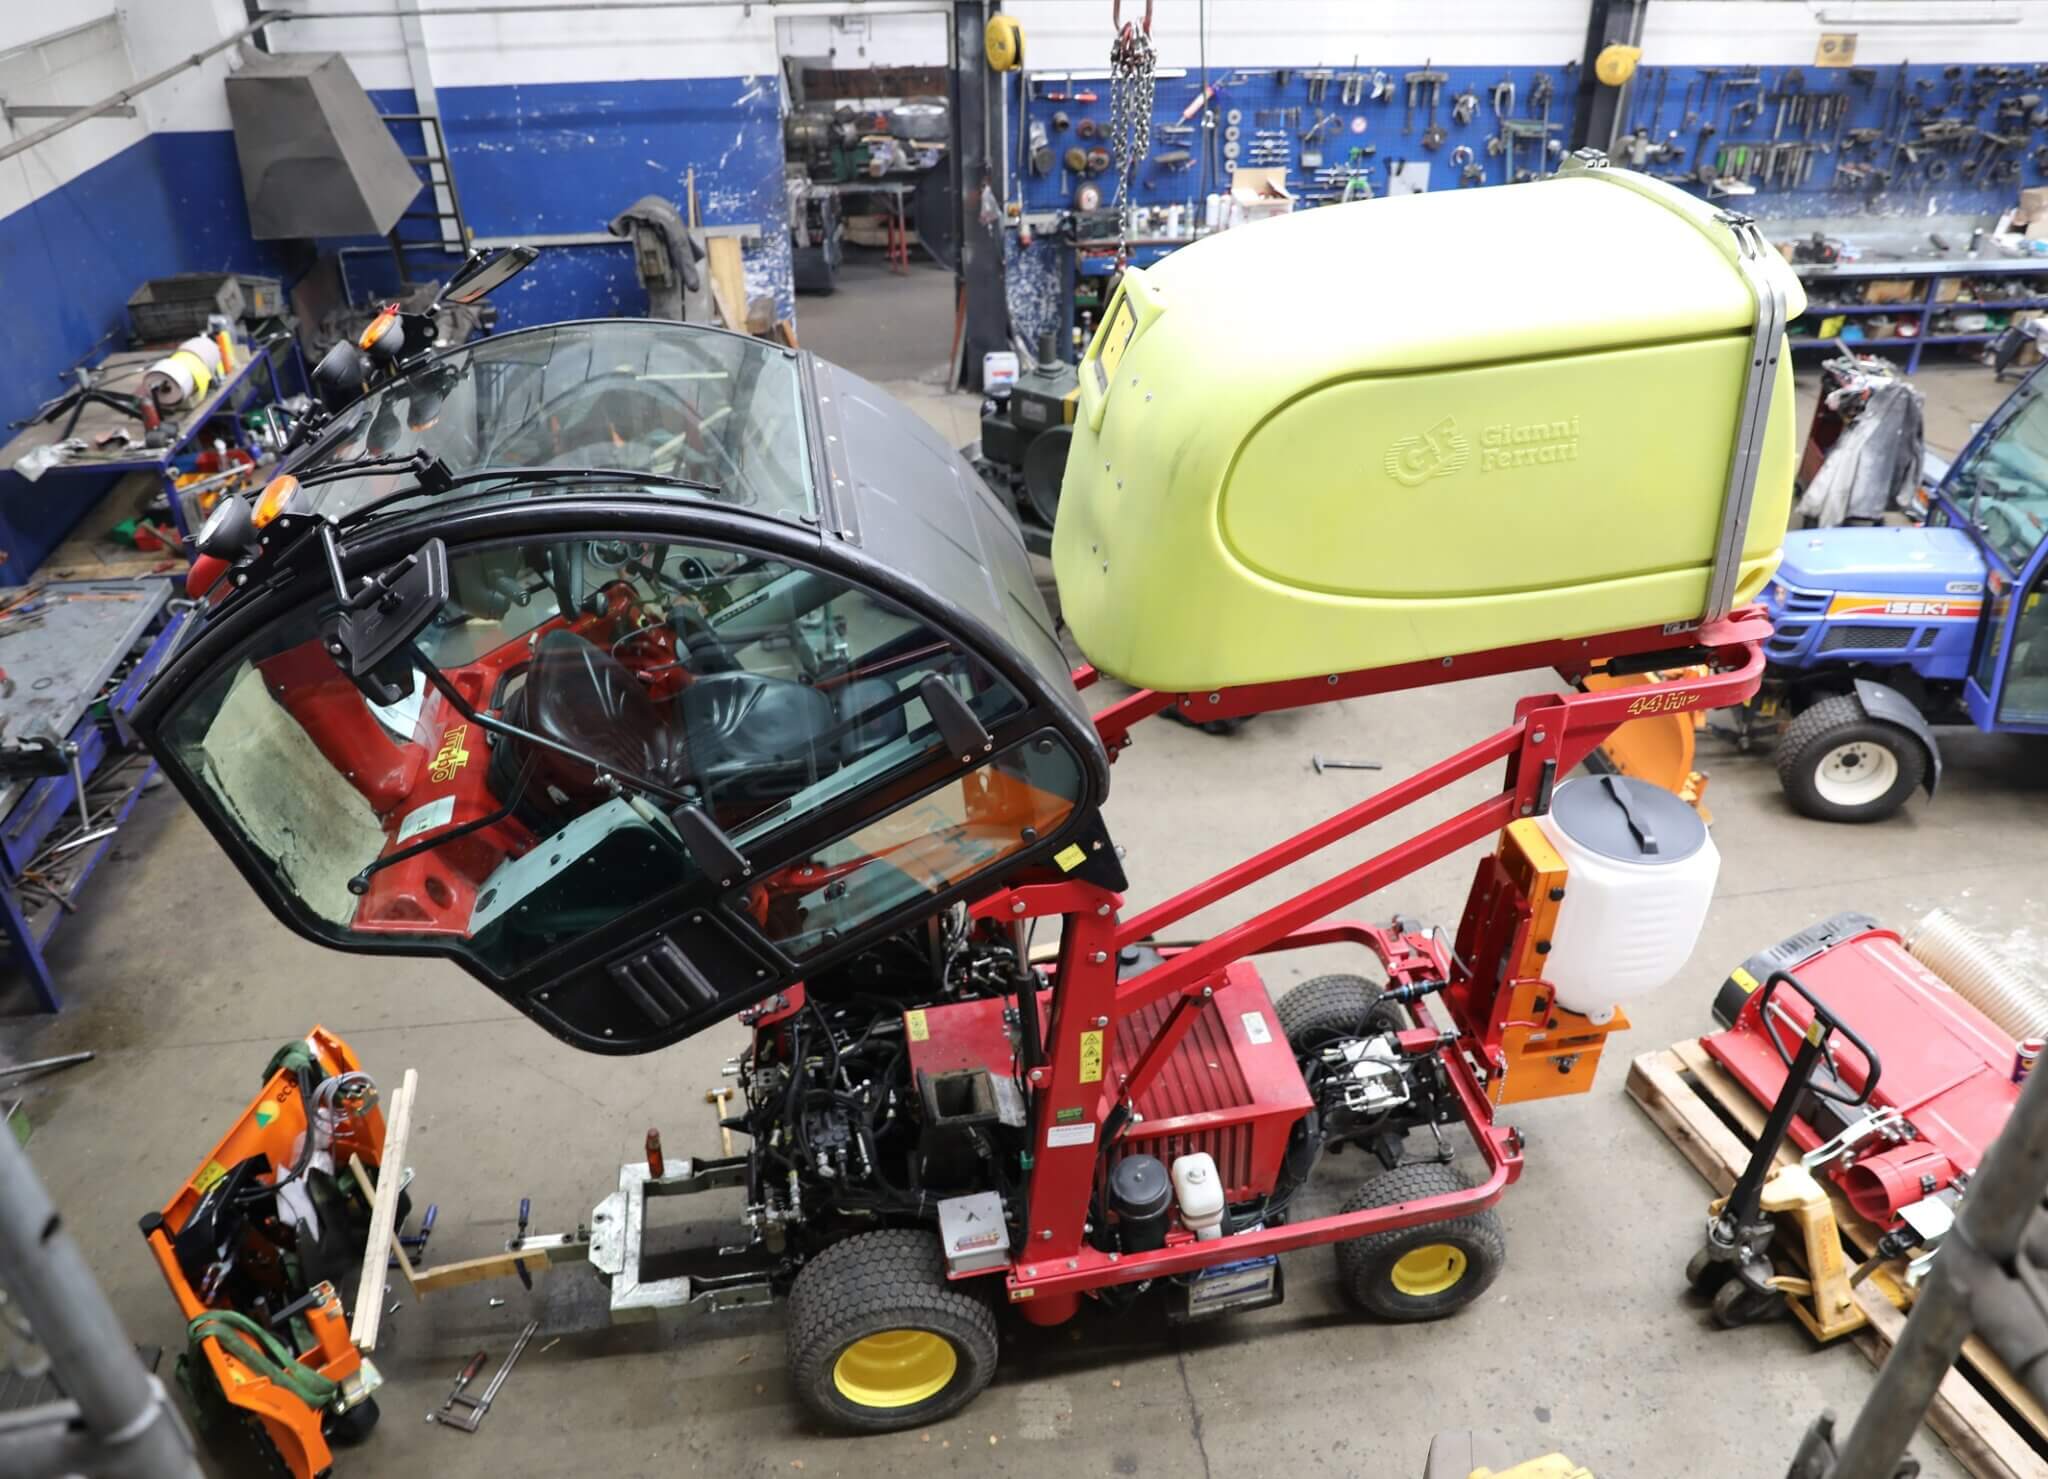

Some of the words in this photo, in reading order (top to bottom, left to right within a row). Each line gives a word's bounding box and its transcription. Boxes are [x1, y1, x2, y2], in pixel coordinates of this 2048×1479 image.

[1480, 415, 1580, 448] Gianni
[1480, 438, 1579, 473] Ferrari
[1884, 601, 1949, 615] ISEKI
[1627, 694, 1663, 715] 44
[431, 724, 467, 783] Turbo
